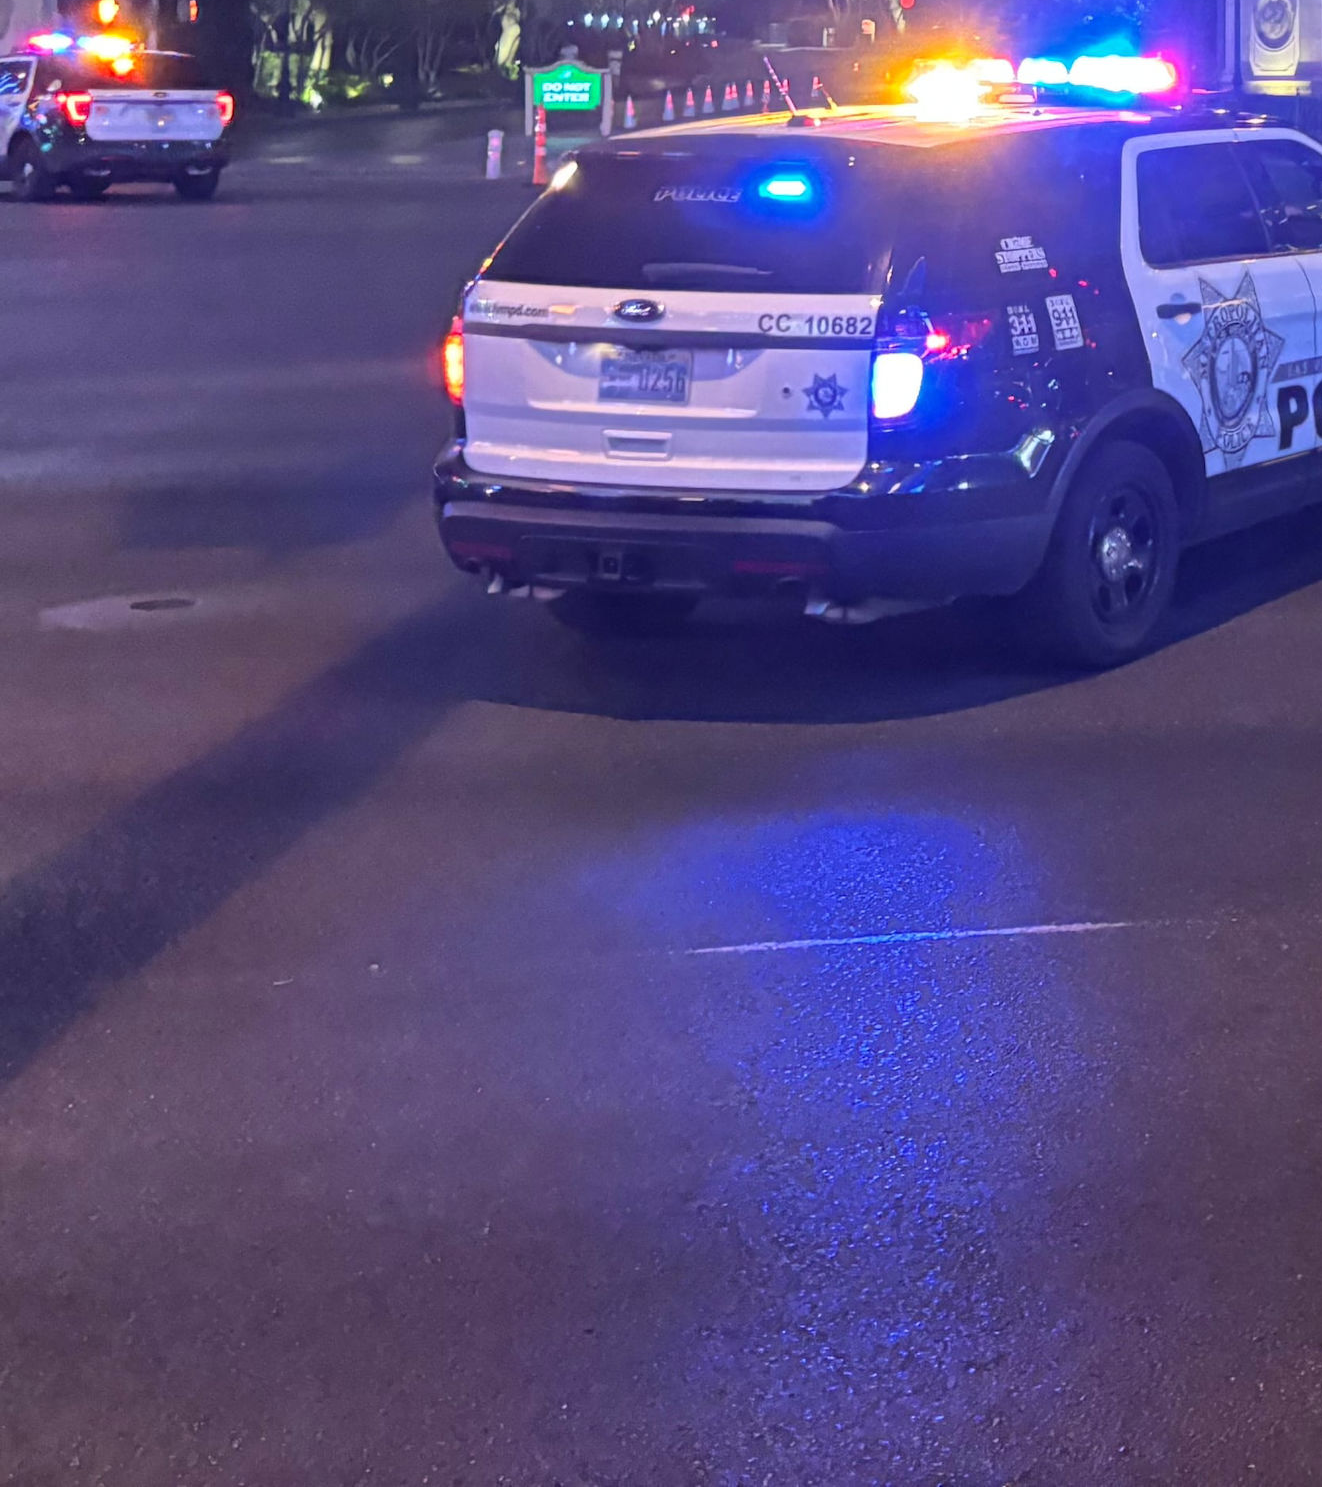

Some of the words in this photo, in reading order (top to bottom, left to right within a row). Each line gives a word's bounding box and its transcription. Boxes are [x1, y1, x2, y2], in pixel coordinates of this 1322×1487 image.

[541, 81, 563, 92] DO
[563, 81, 592, 92] NOT
[543, 92, 590, 103] ENTER
[653, 185, 743, 203] POLICE
[758, 314, 792, 332] CC
[805, 316, 873, 335] 10682
[1287, 361, 1307, 377] LAS
